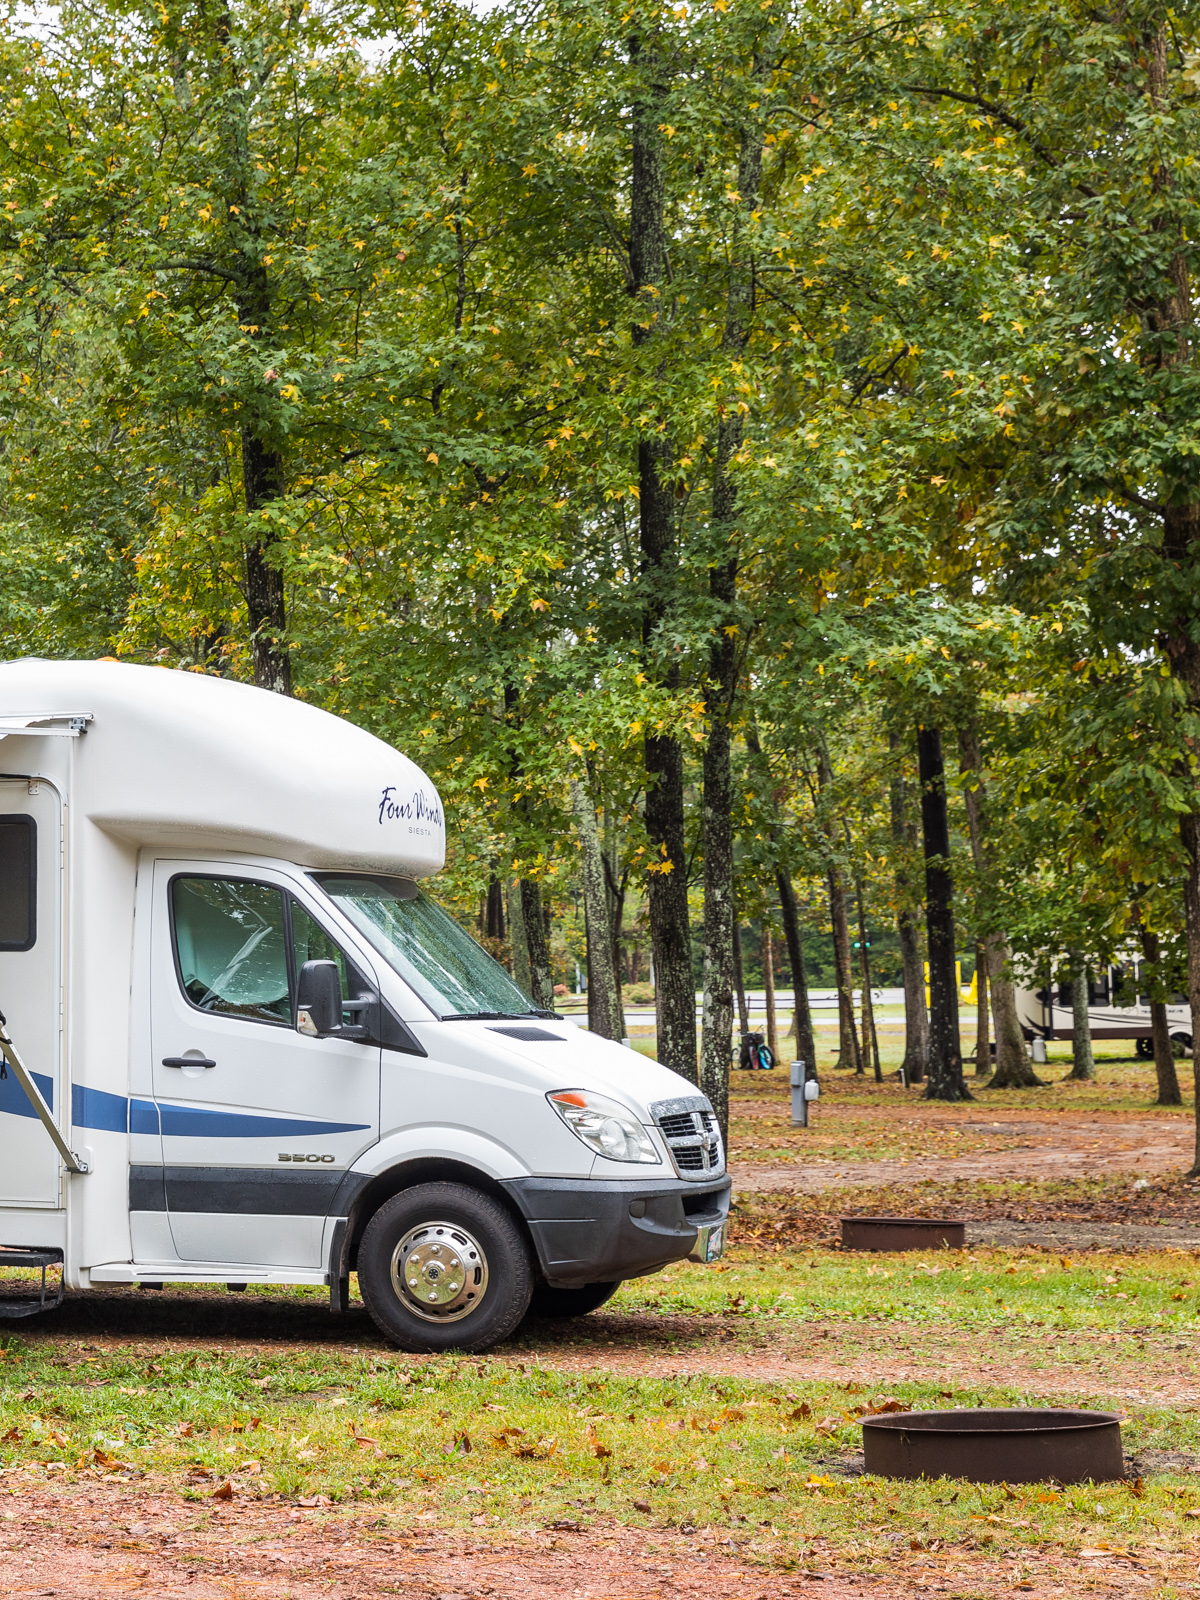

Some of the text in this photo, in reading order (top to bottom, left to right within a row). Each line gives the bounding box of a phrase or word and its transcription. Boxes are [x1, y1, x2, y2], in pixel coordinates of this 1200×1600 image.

[378, 786, 413, 825] Four
[408, 826, 432, 837] SIESTA
[278, 1153, 336, 1163] 3500
